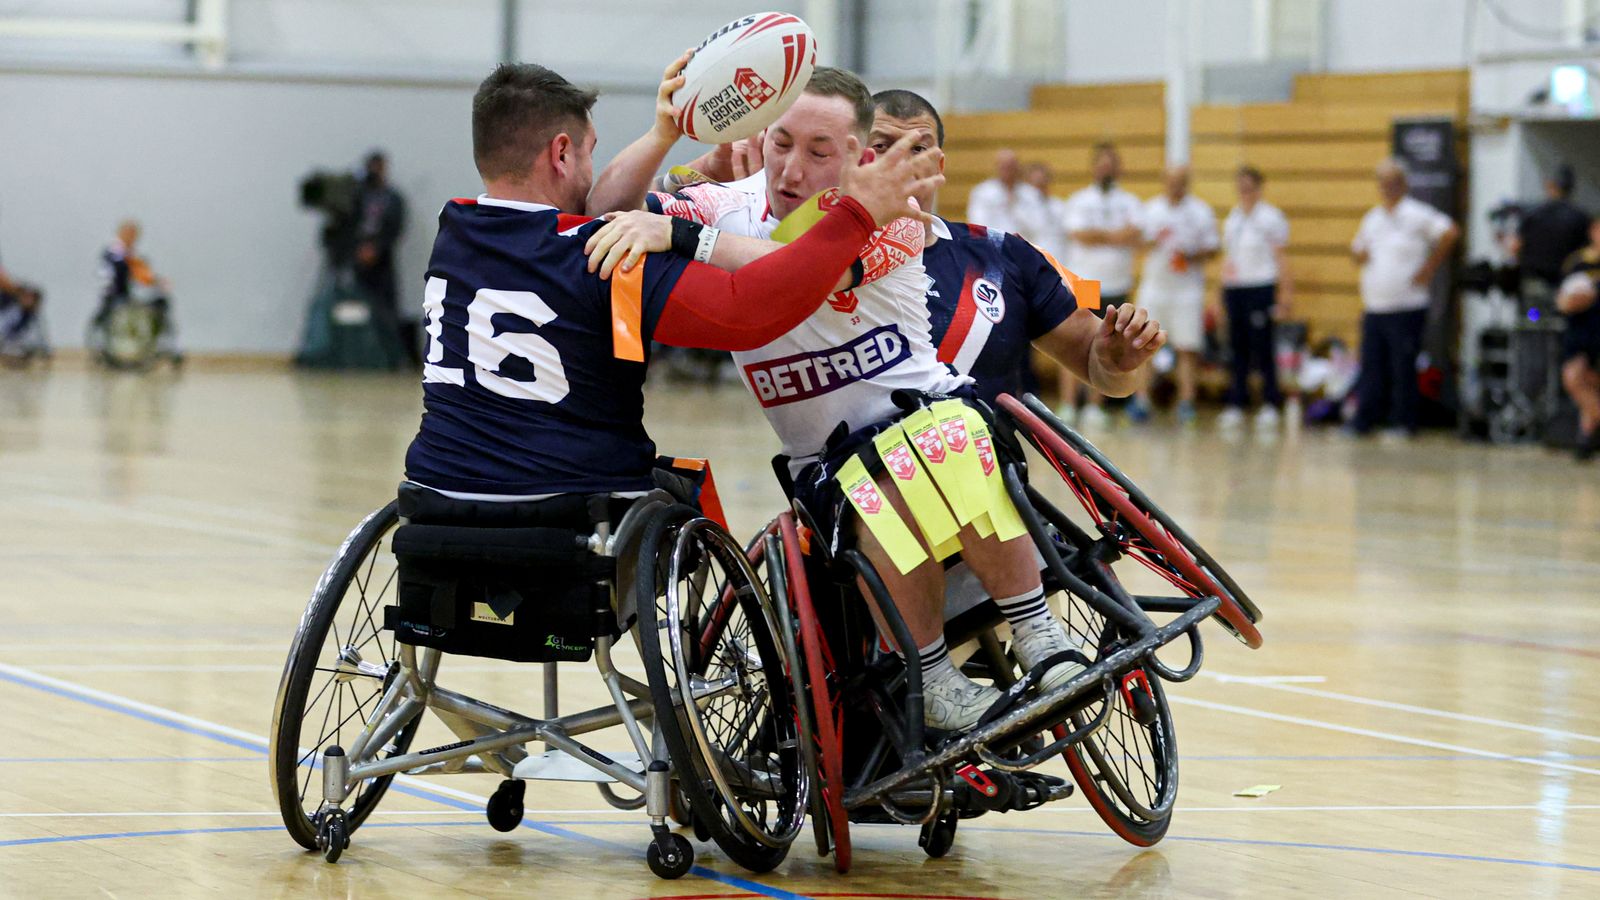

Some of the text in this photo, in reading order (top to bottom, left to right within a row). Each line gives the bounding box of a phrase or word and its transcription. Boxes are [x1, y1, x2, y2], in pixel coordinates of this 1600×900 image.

[698, 84, 737, 116] LEAGUE
[707, 94, 745, 126] RUGBY
[714, 105, 751, 133] ENGLAND
[850, 315, 861, 326] 33
[422, 276, 570, 405] 16
[751, 330, 902, 402] BETFRED
